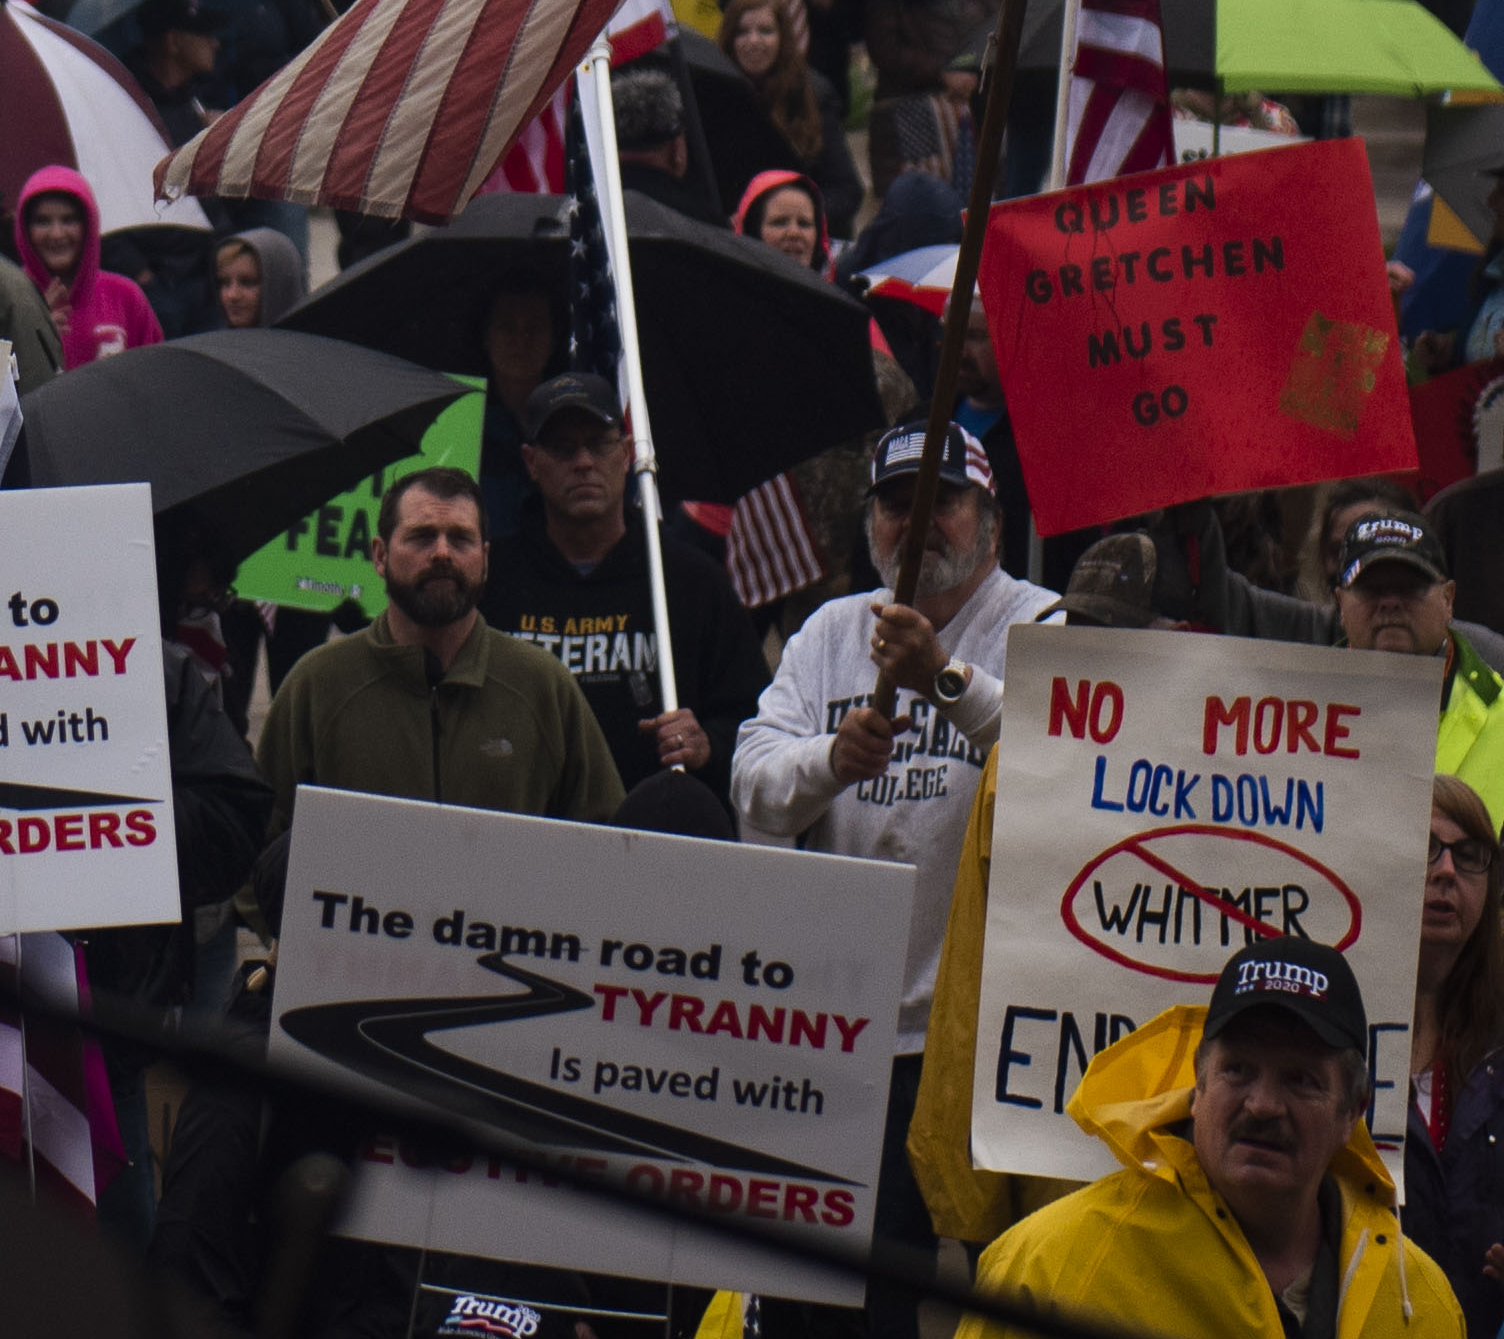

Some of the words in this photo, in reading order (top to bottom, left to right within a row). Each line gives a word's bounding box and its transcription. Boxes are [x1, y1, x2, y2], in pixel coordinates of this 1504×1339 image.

[1054, 175, 1217, 234] QUEEN
[1025, 235, 1286, 305] GRETCHEN
[1087, 314, 1218, 369] MUST
[1132, 385, 1189, 427] GO
[285, 503, 372, 561] FEA
[8, 592, 60, 627] to
[563, 612, 630, 635] ARMY
[21, 708, 109, 746] with
[1048, 677, 1124, 744] NO
[1202, 696, 1362, 759] MORE
[312, 890, 415, 939] The
[432, 910, 582, 962] damn
[599, 937, 722, 981] road
[740, 949, 795, 990] to
[1093, 880, 1310, 947] WHITMER
[1238, 960, 1329, 997] Trump
[1264, 979, 1300, 994] 2020
[593, 984, 870, 1053] TYRANNY
[550, 1047, 581, 1083] Is
[593, 1058, 720, 1103] paved
[732, 1075, 826, 1116] with
[625, 1163, 856, 1227] ORDERS
[450, 1295, 539, 1339] Trump
